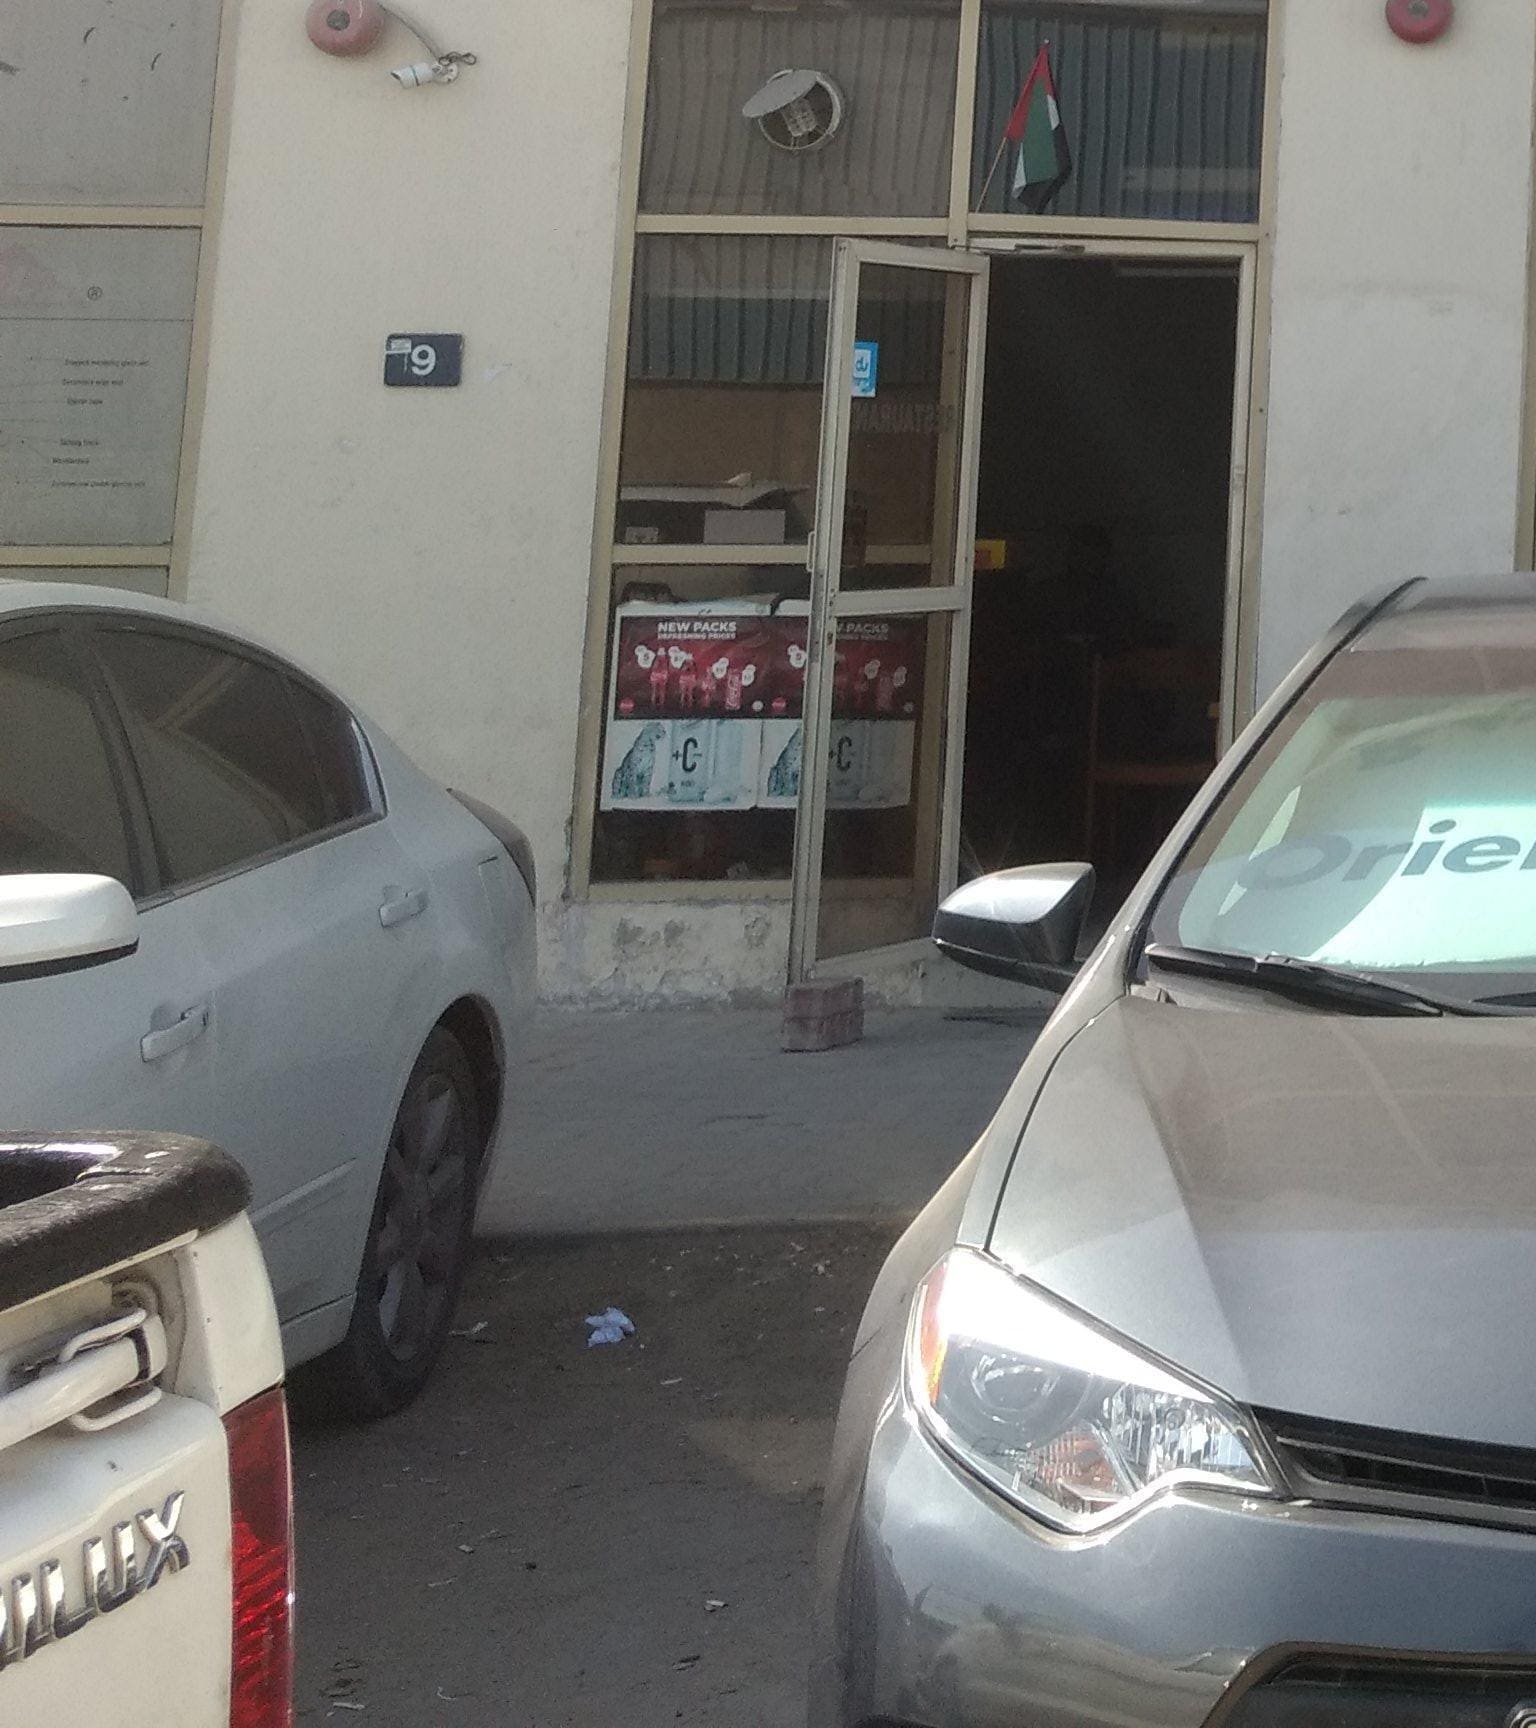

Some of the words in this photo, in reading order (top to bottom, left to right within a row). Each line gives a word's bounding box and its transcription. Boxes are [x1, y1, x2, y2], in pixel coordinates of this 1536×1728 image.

[411, 344, 436, 376] 9
[658, 622, 690, 632] NEW
[694, 622, 737, 632] PACKS
